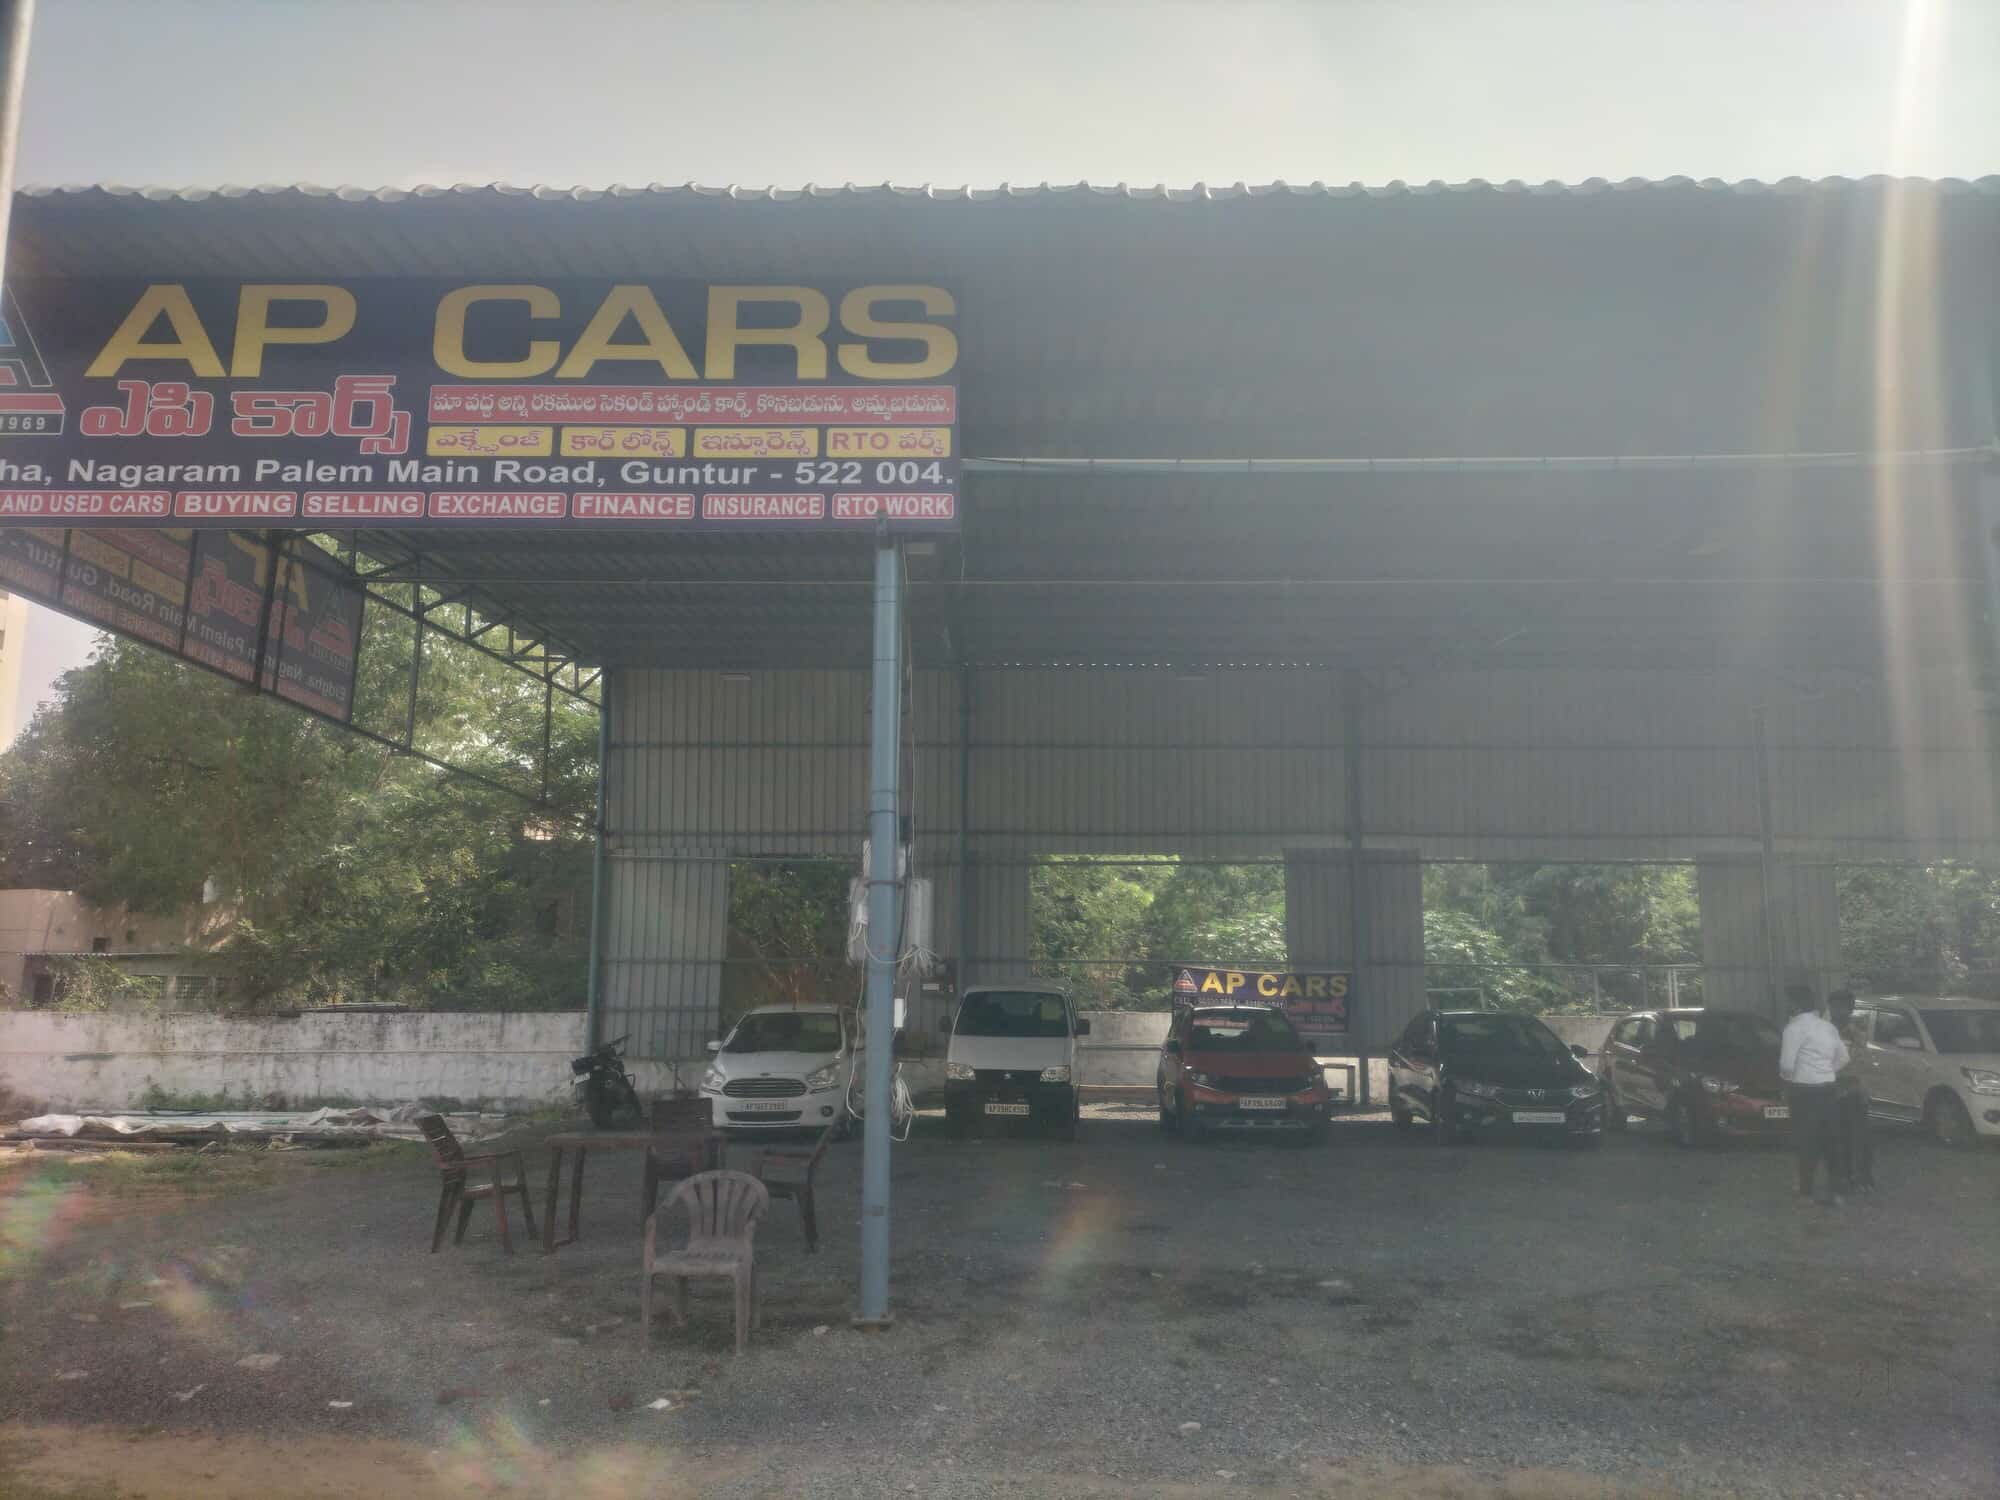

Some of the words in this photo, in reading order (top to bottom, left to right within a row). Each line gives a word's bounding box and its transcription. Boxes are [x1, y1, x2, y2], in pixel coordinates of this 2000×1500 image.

[84, 284, 357, 377] AP
[433, 284, 958, 380] CARS
[433, 393, 462, 411] మా
[80, 380, 214, 437] ఎపి
[231, 375, 411, 455] కార్స్
[571, 430, 616, 450] కార్
[832, 432, 890, 450] RTO
[67, 459, 240, 488] Nagaram
[255, 459, 373, 483] Palem
[388, 460, 479, 484] Main
[494, 460, 605, 487] Road,
[620, 461, 758, 485] Guntur
[795, 461, 862, 484] 522
[876, 461, 953, 485] 004.
[3, 495, 43, 512] AND
[50, 495, 103, 512] USED
[109, 495, 164, 512] CARS
[184, 495, 292, 513] BUYING
[307, 495, 419, 513] SELLING
[437, 495, 560, 514] EXCHANGE
[579, 496, 691, 515] FINANCE
[707, 497, 821, 515] INSURANCE
[837, 497, 880, 515] RTO
[885, 497, 949, 515] WORK
[1201, 972, 1245, 995] AP
[1257, 974, 1348, 998] CARS
